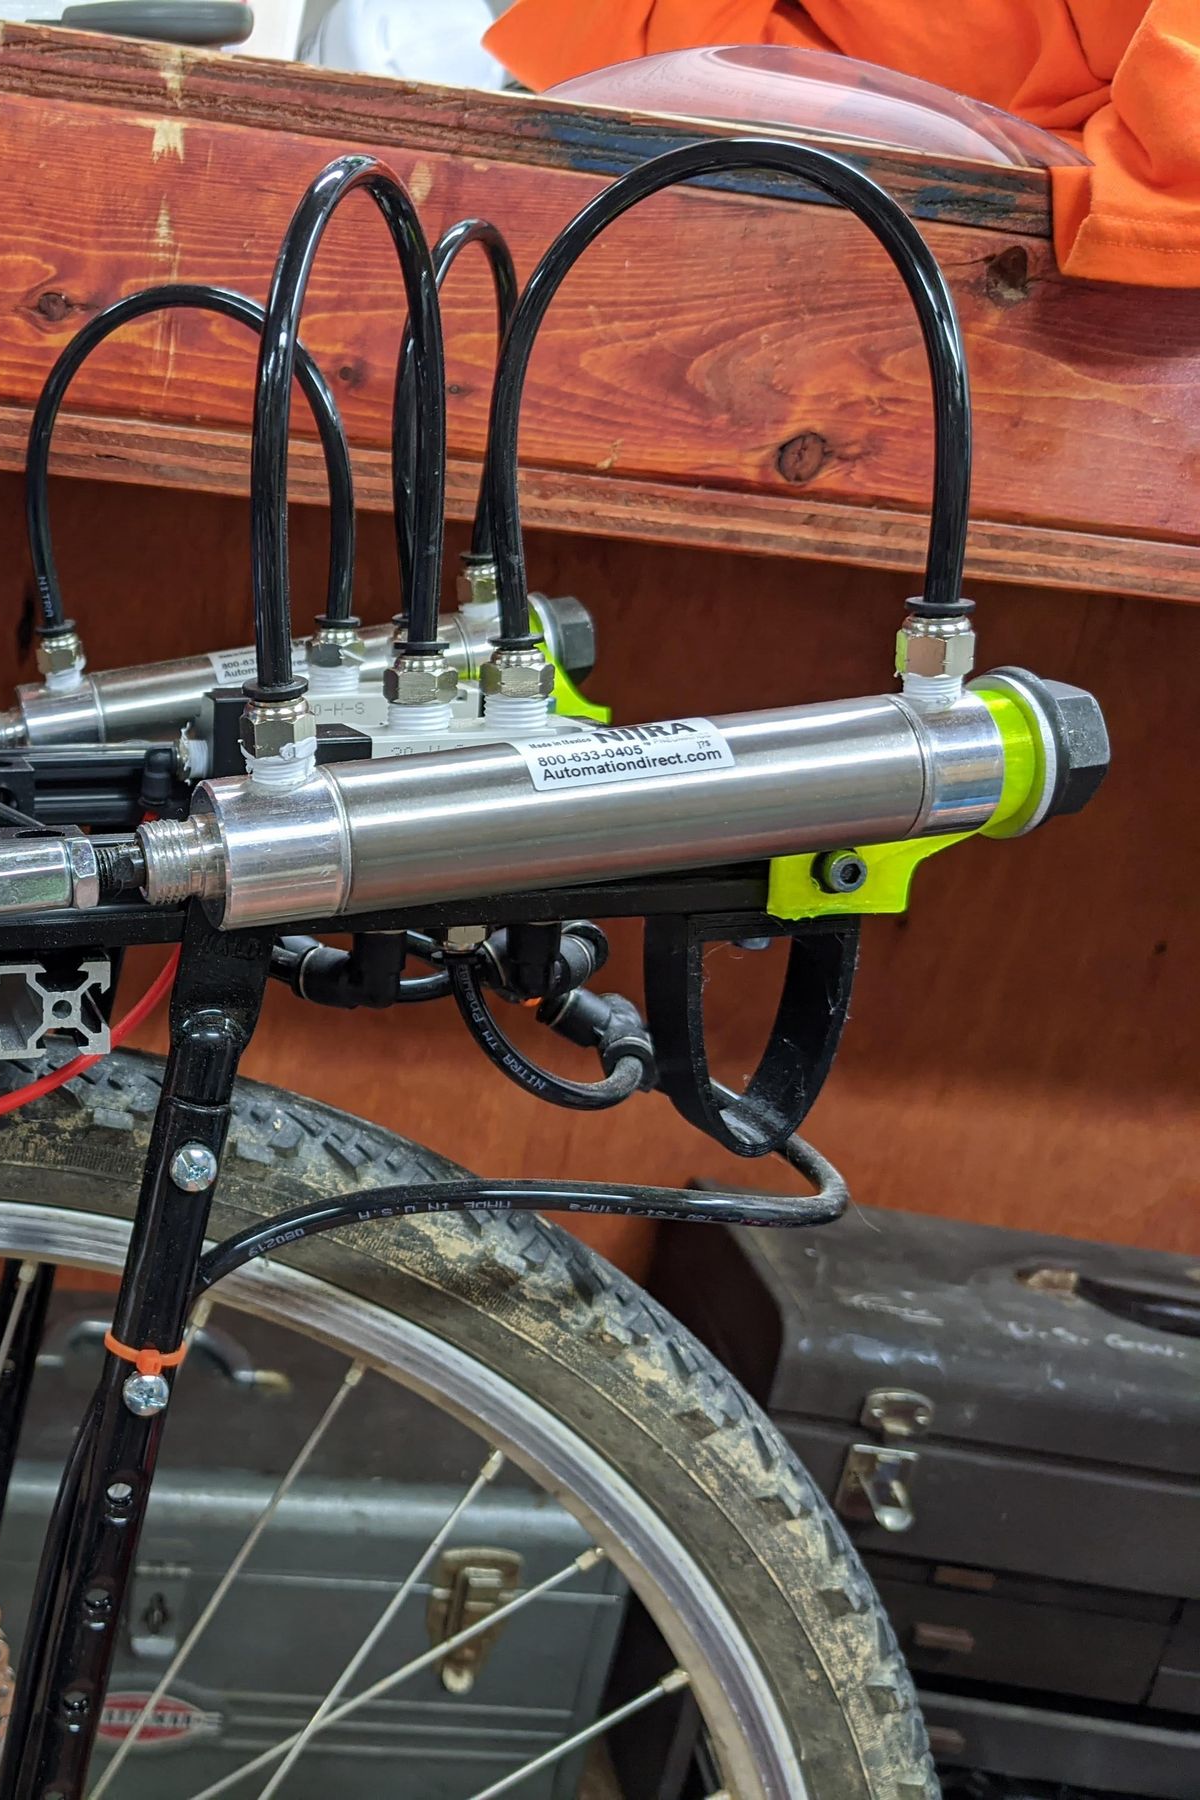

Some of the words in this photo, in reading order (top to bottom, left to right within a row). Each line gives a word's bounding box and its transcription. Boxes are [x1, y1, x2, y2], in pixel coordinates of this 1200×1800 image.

[310, 701, 365, 716] 0-H-S
[537, 744, 643, 767] 800-633-0405
[543, 750, 722, 781] Automationdirect.com
[482, 1030, 499, 1050] TM
[503, 1053, 546, 1090] NITRA
[427, 1202, 450, 1211] IN
[464, 1200, 511, 1210] MADE
